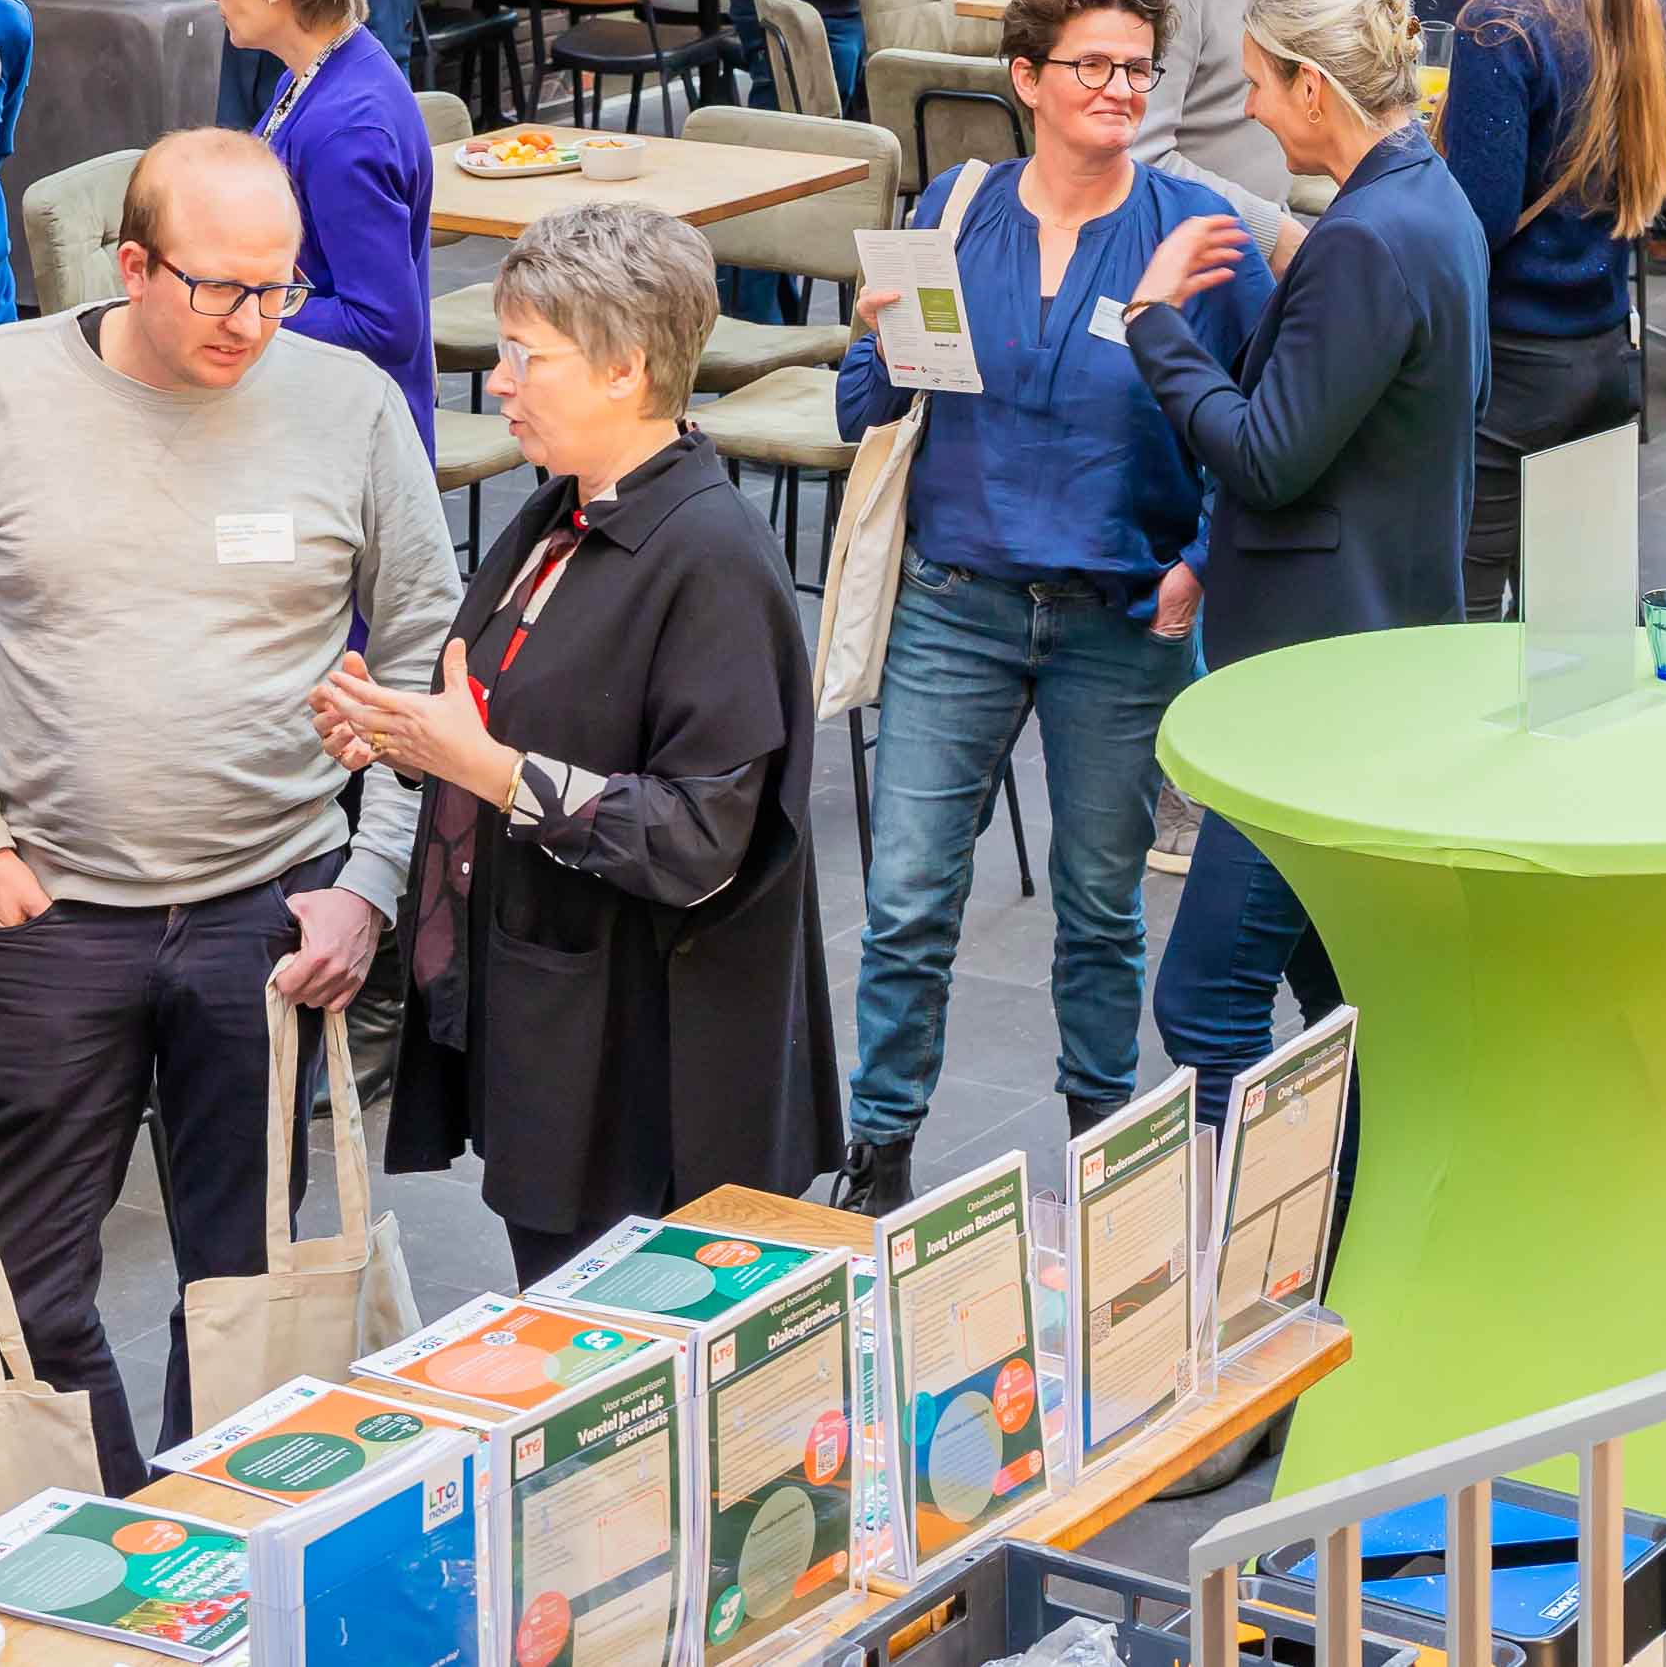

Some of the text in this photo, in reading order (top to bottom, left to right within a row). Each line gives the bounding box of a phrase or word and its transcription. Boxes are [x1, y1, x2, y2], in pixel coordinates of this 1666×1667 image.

[925, 1201, 1016, 1257] Jong Leren Besturen
[767, 1300, 841, 1351] Dialoogtraining
[577, 1392, 666, 1447] Verstel je rol als
[602, 1397, 620, 1413] Voor
[614, 1411, 670, 1447] secretaris
[428, 1480, 457, 1510] LTO
[428, 1497, 460, 1520] noord
